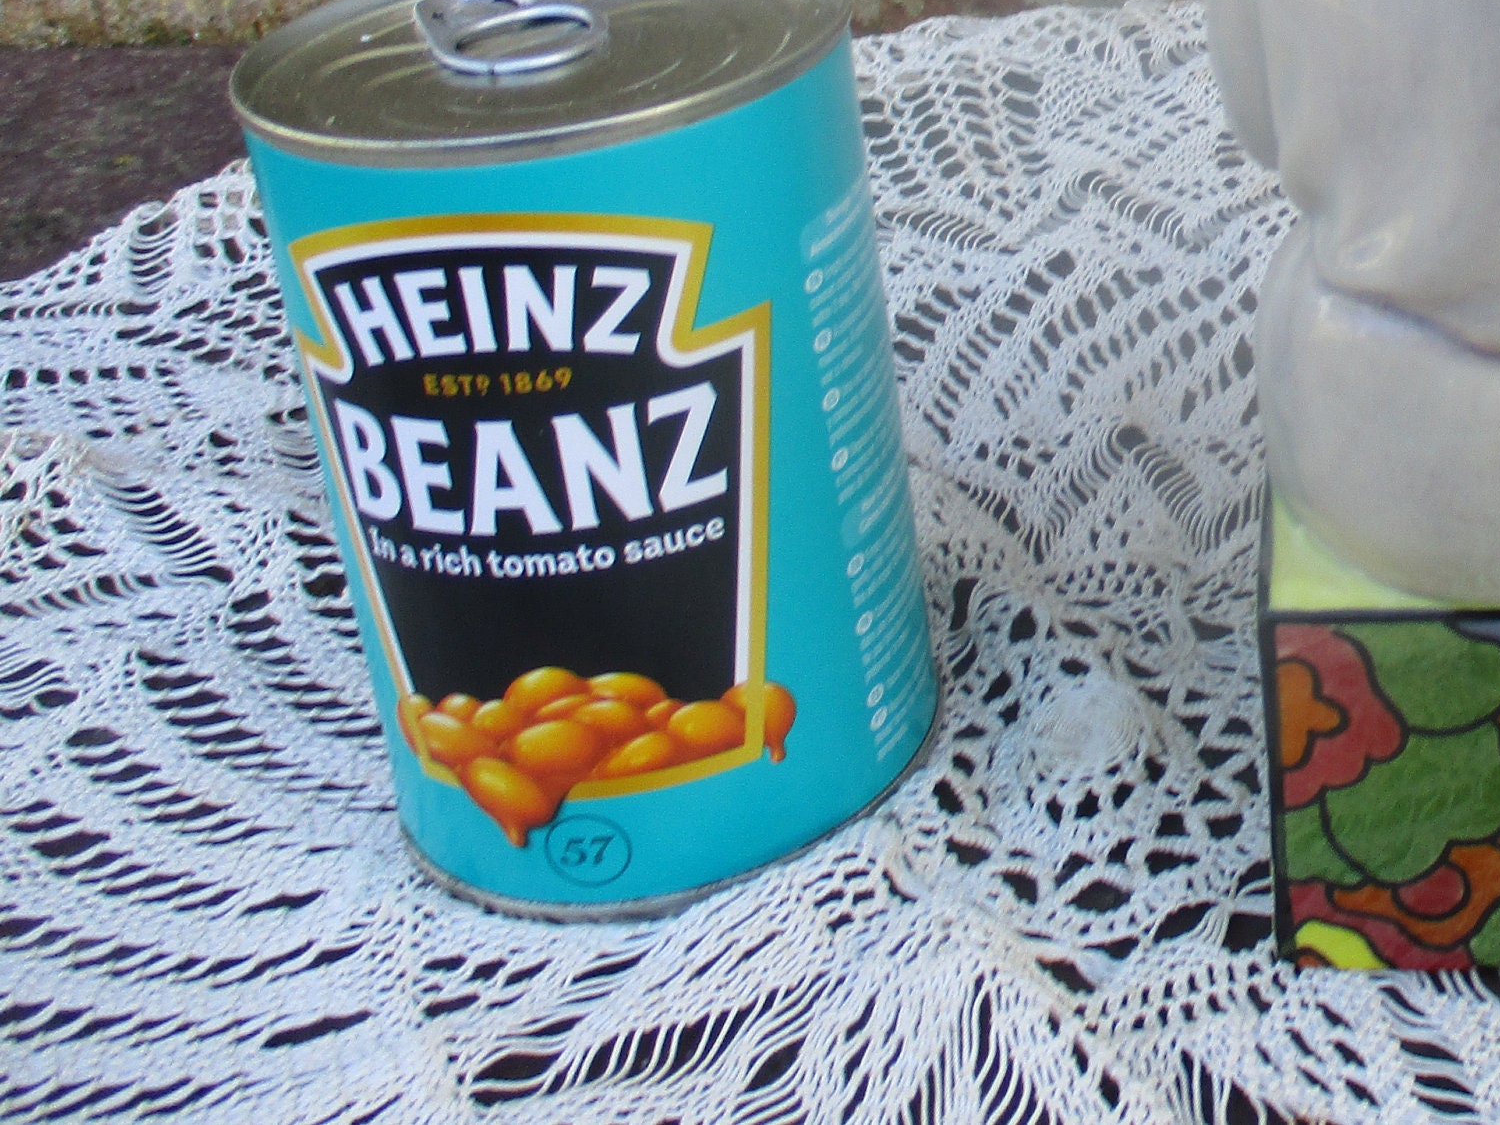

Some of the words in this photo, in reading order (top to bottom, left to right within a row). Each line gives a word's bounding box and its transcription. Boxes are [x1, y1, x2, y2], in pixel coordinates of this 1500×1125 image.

[333, 264, 652, 367] HEINZ
[499, 365, 574, 396] 1869
[334, 380, 729, 537] BEANZ
[368, 525, 397, 563] In
[400, 543, 418, 569] a
[419, 542, 483, 577] rich
[486, 543, 616, 579] tomato
[623, 515, 726, 565] sauce
[560, 835, 616, 868] 57
